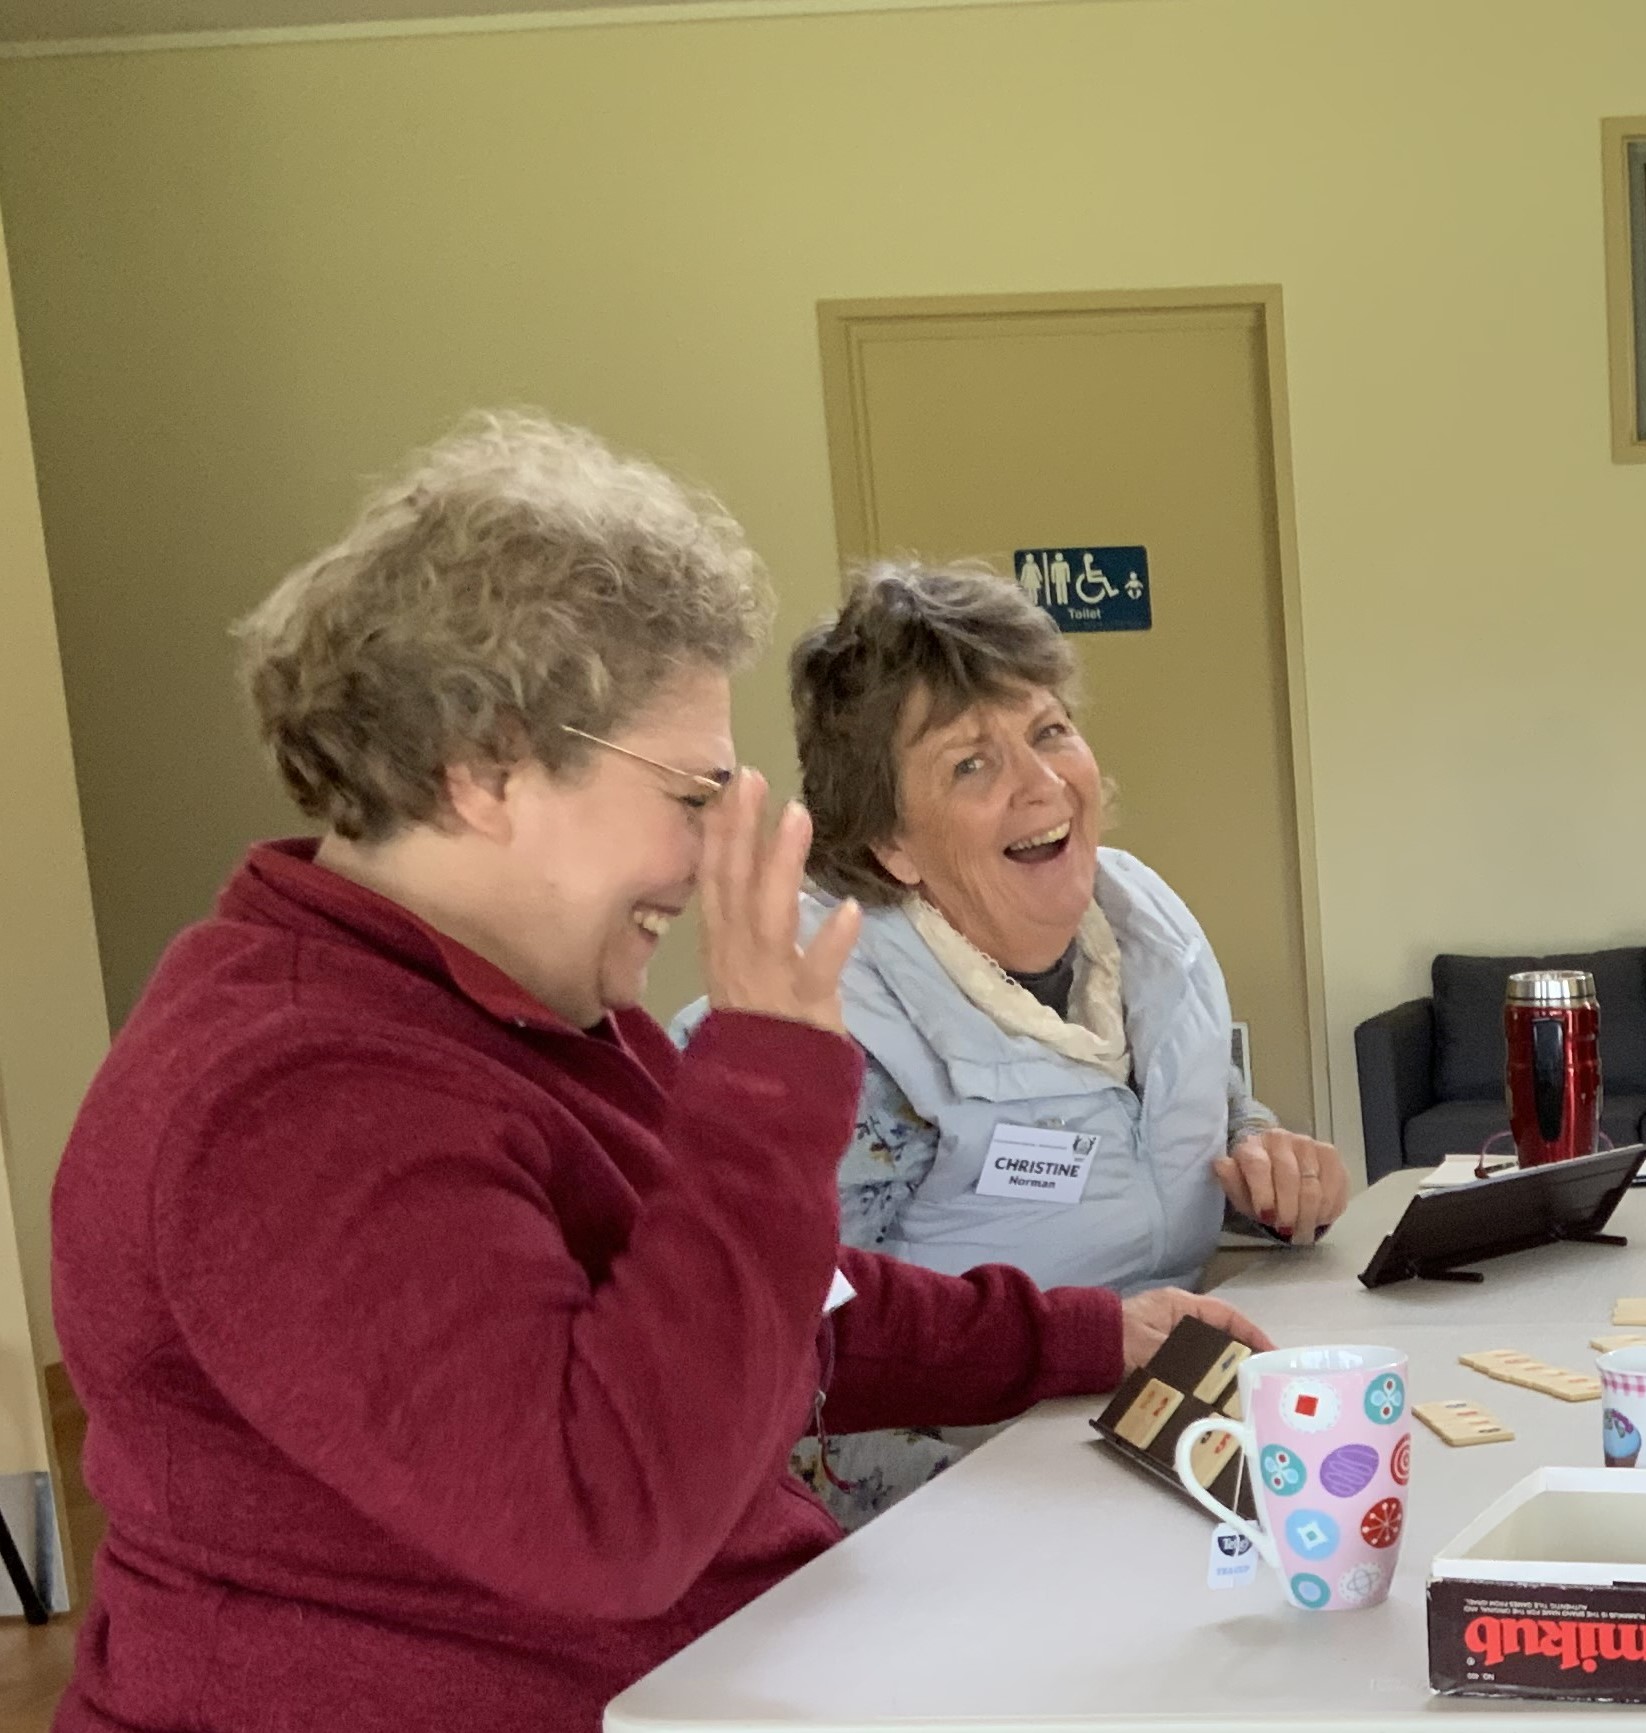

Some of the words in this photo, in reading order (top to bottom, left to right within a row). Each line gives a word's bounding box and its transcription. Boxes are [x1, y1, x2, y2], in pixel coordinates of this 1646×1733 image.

[1068, 608, 1101, 620] Toilet
[995, 1157, 1080, 1177] CHRISTINE
[1009, 1175, 1055, 1188] Norman
